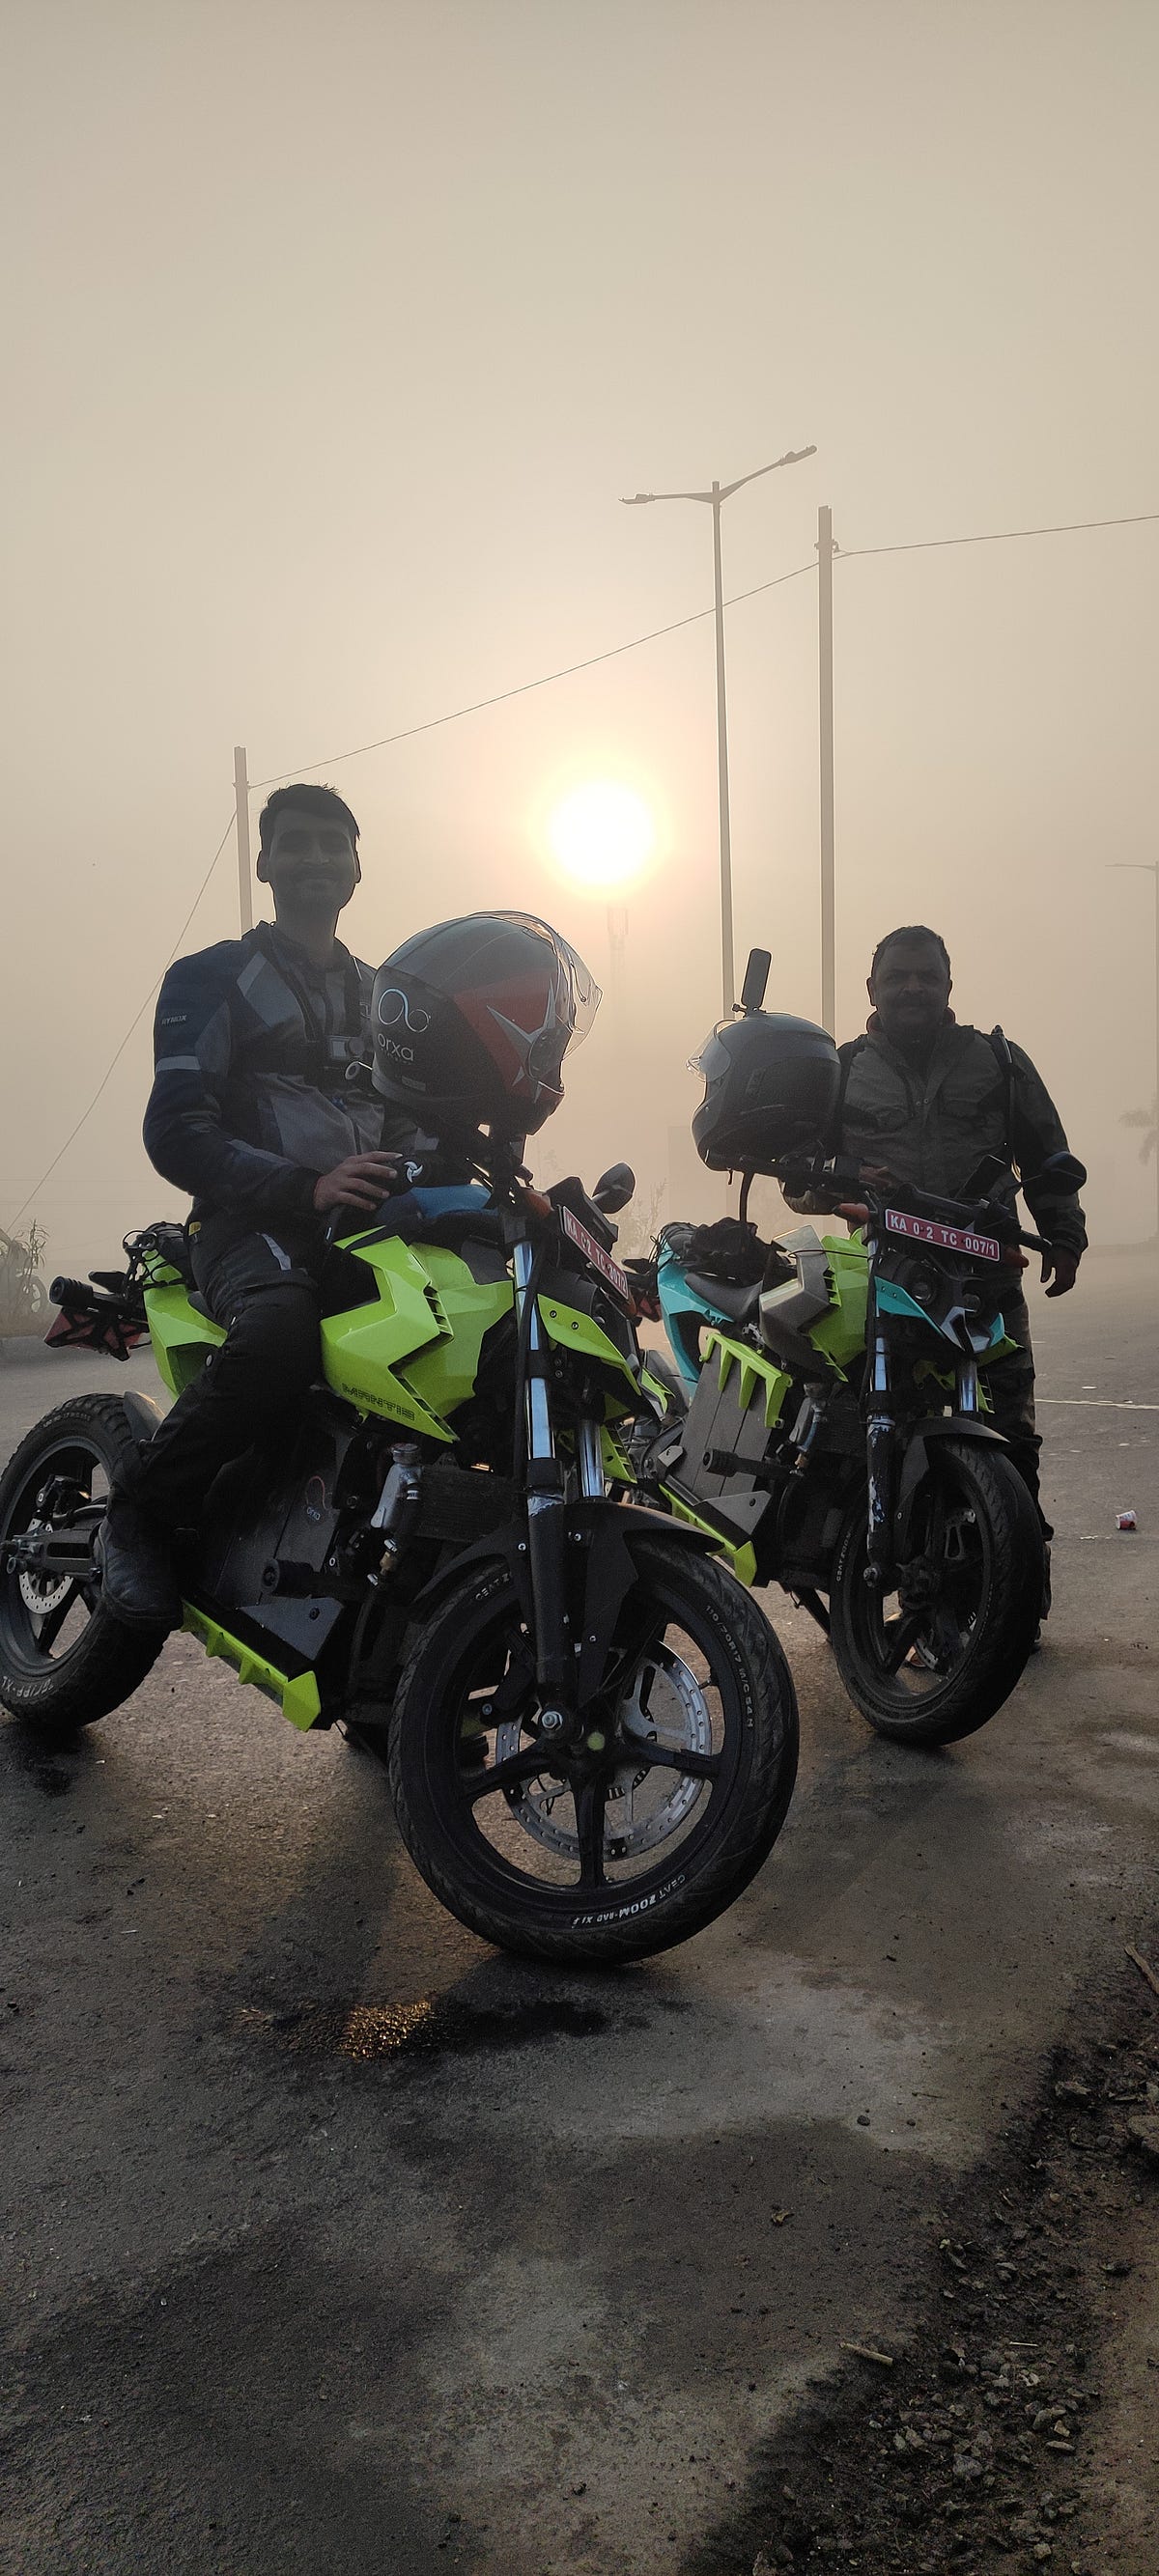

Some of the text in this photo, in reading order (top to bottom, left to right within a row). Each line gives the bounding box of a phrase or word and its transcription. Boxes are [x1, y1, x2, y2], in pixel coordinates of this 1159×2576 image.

[378, 1033, 413, 1061] orxa
[567, 1215, 579, 1240] KA
[595, 1247, 606, 1271] TC
[890, 1215, 907, 1231] KA
[941, 1230, 957, 1246] TC
[965, 1237, 995, 1256] 007/1
[341, 1383, 415, 1421] MANTIS
[658, 1874, 686, 1899] CEAT
